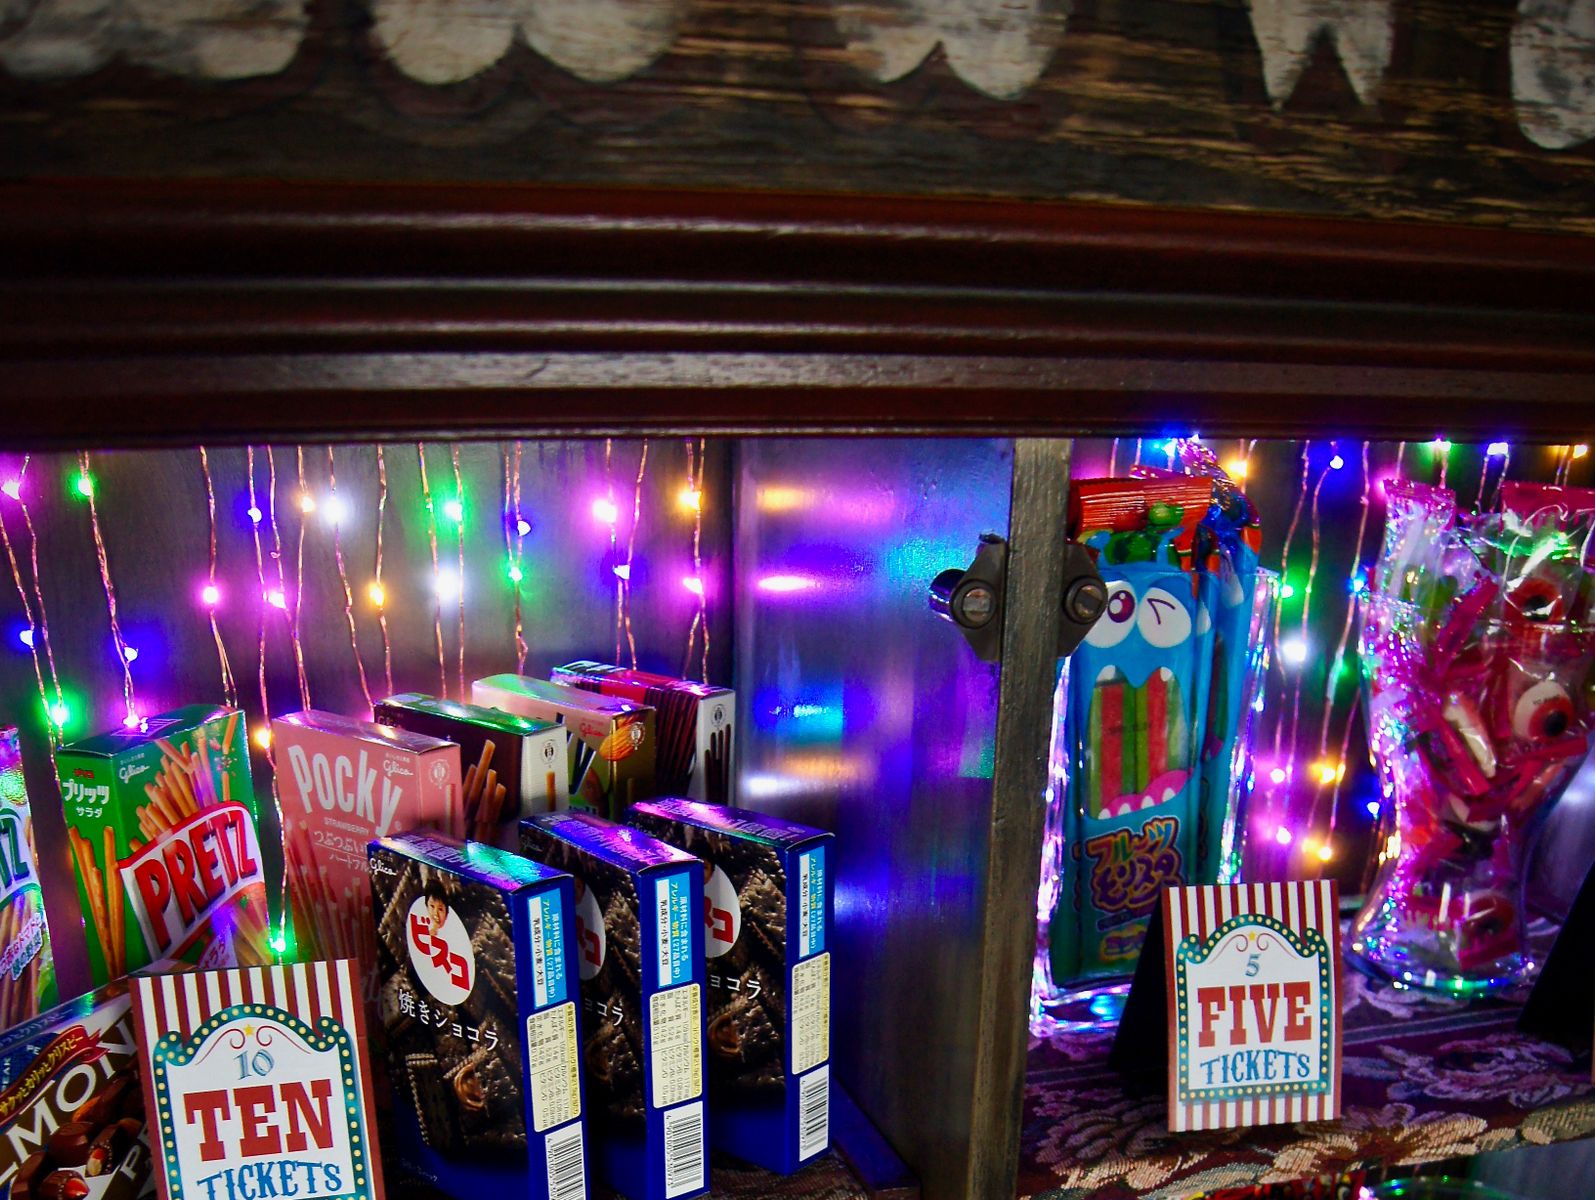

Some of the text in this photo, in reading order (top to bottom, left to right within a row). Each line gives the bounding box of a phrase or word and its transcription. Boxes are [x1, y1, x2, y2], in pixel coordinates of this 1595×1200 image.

[62, 779, 110, 804] プリッツ
[76, 806, 102, 818] サラダ
[134, 810, 258, 953] PRETZ
[370, 857, 398, 877] Glico
[410, 913, 471, 991] ビスコ
[1245, 953, 1262, 977] 5
[398, 988, 499, 1051] 焼きショコラ
[1197, 981, 1312, 1048] FIVE
[232, 1049, 275, 1080] 10
[1200, 1049, 1310, 1085] TICKETS
[183, 1078, 334, 1162] TEN
